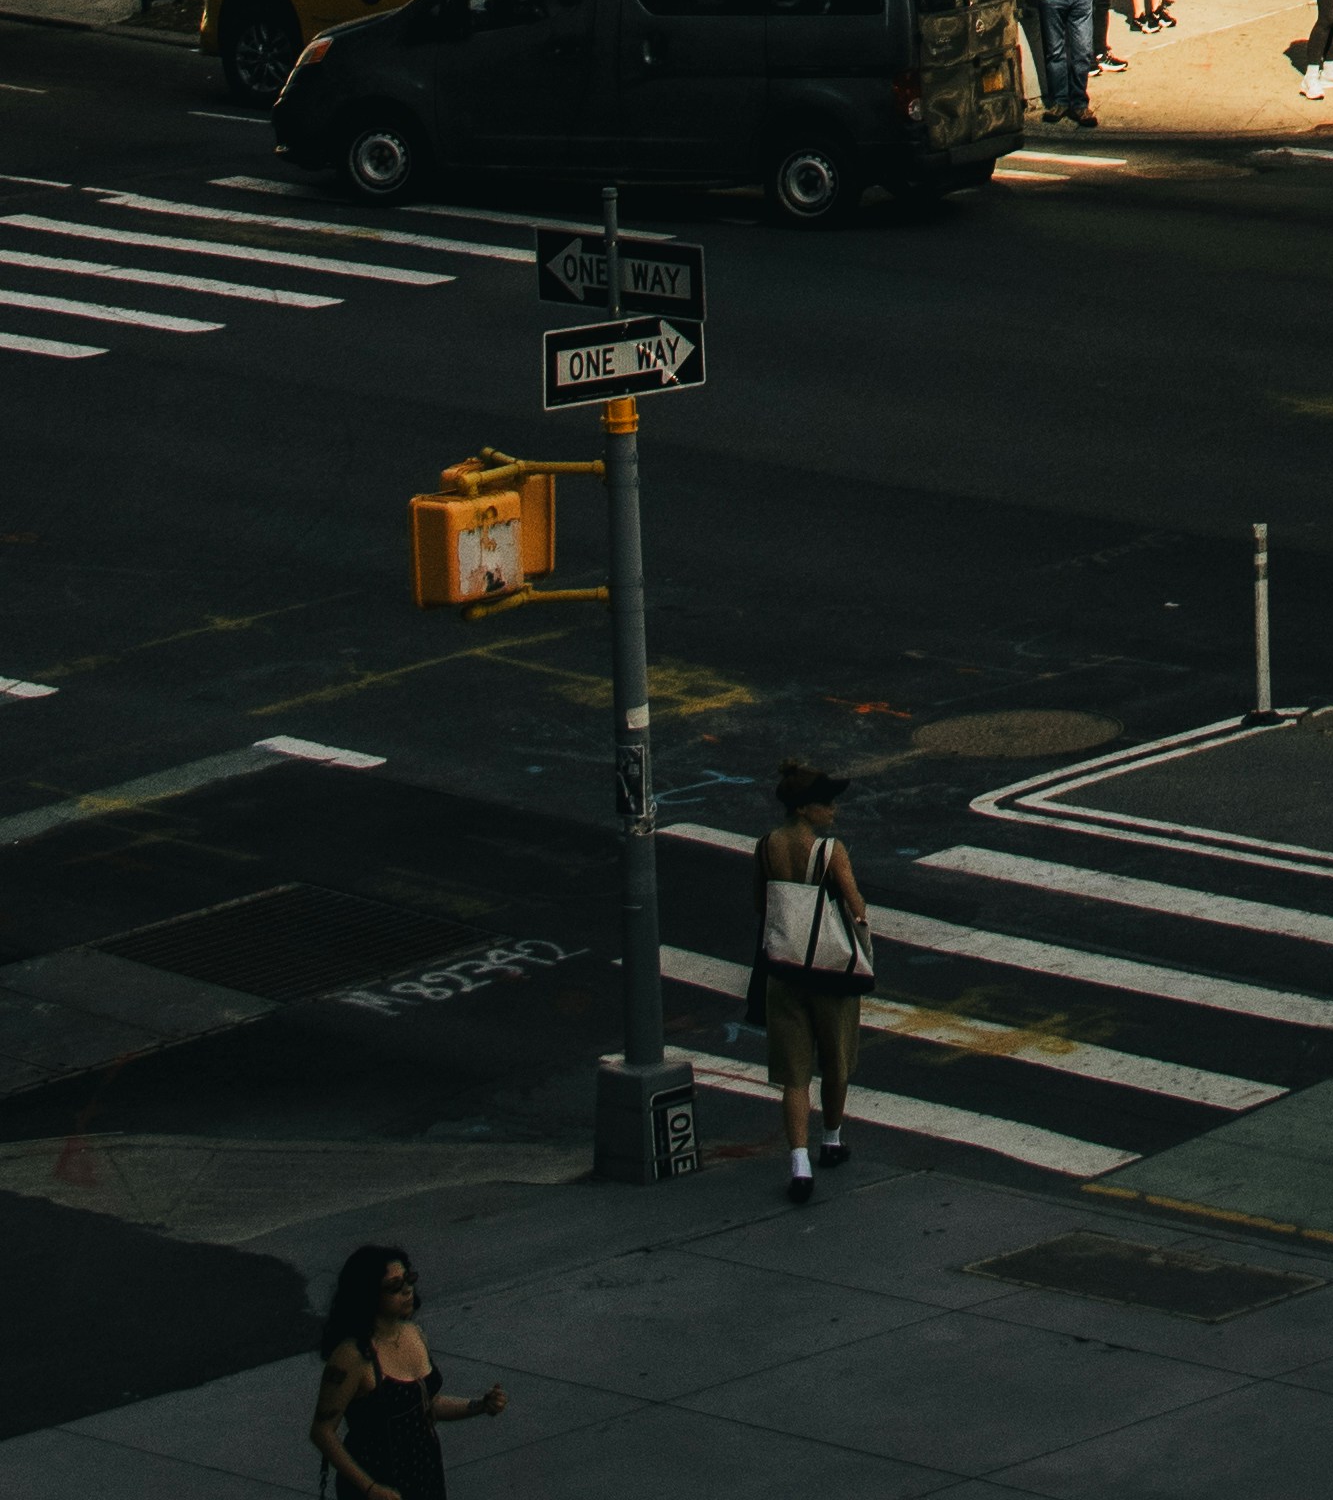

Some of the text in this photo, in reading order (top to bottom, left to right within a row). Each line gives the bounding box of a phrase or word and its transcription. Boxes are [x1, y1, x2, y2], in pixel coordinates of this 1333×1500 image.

[562, 253, 681, 294] ONE WAY
[569, 336, 681, 381] ONE WAY
